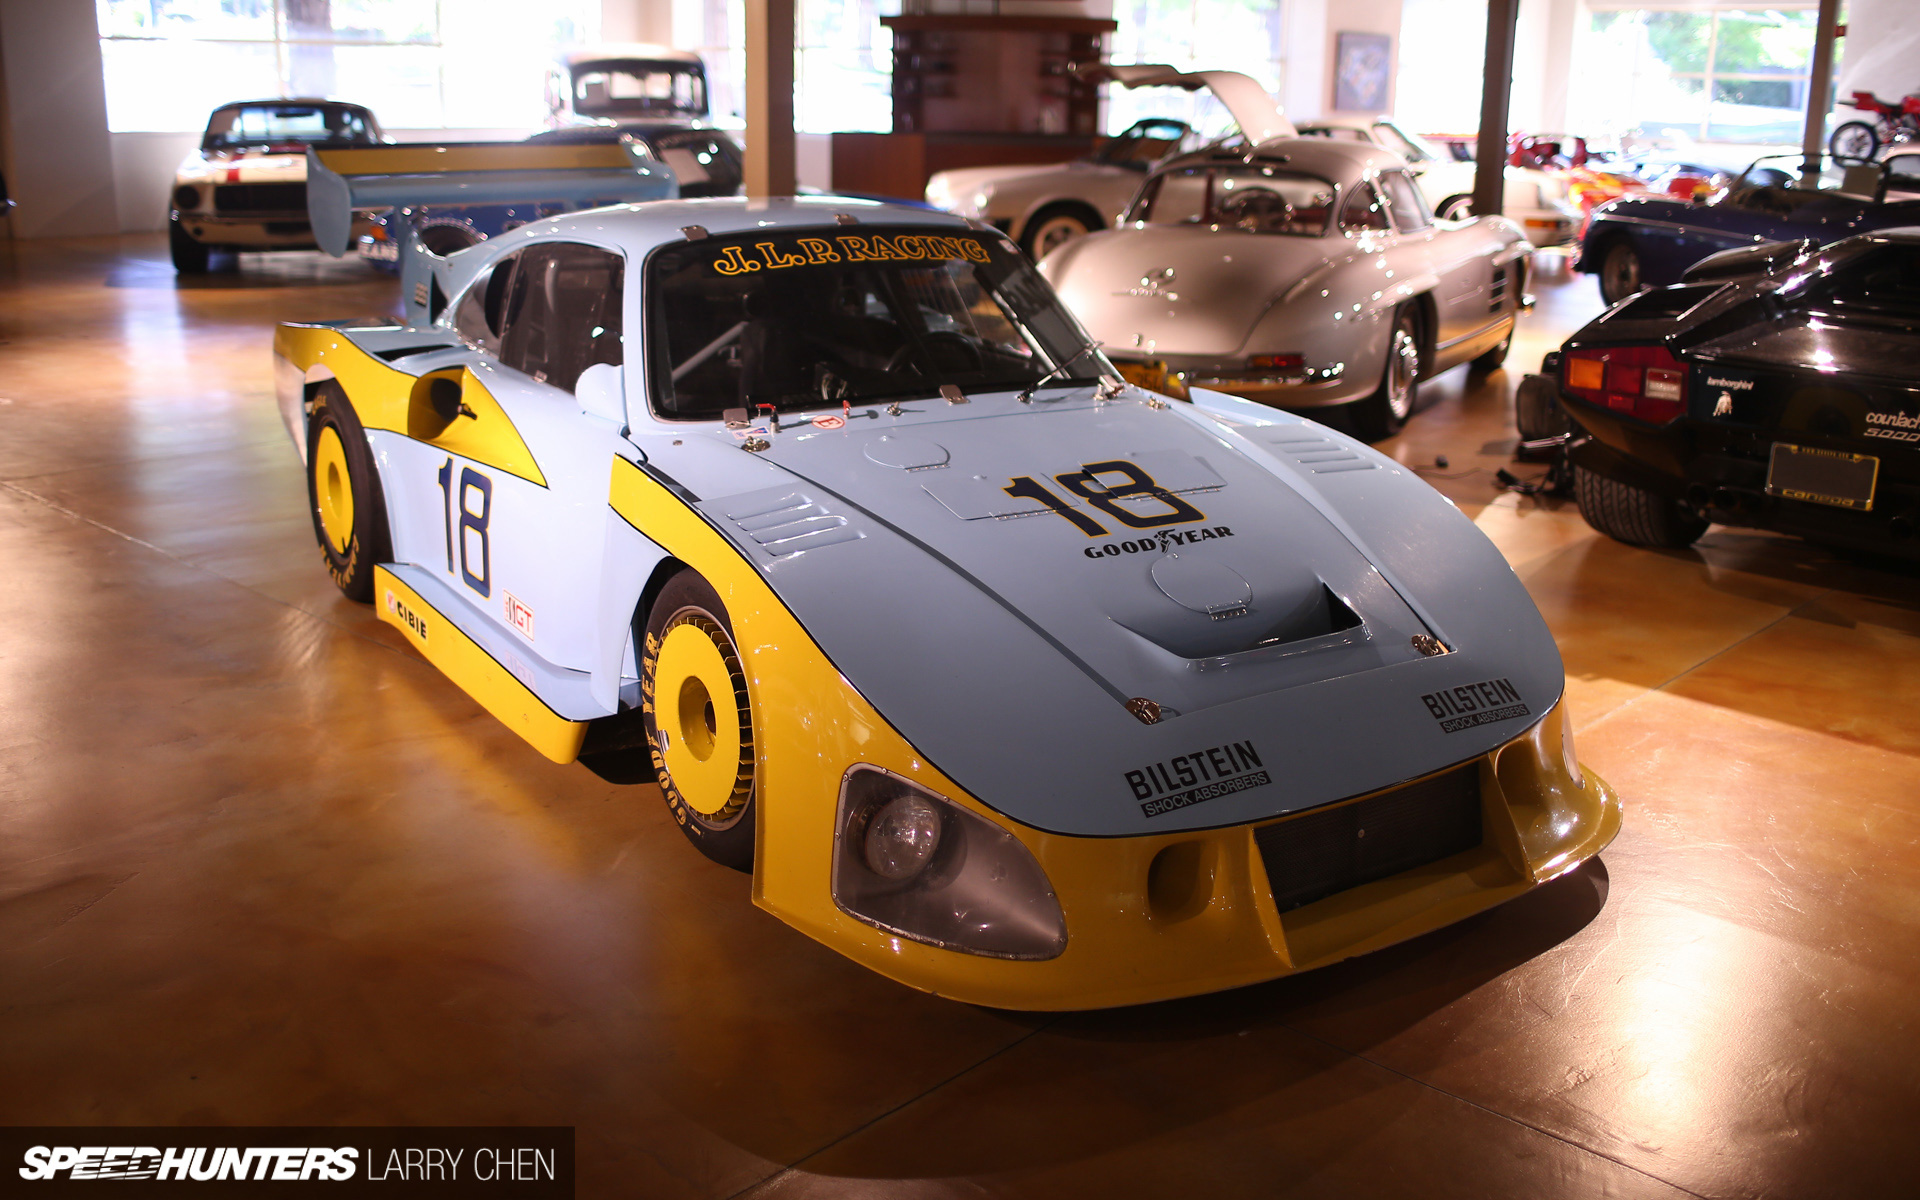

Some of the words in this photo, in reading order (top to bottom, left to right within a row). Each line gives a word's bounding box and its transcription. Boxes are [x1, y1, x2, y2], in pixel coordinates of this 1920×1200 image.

[714, 238, 841, 275] J.L.P.
[836, 235, 991, 263] RACING
[1863, 428, 1920, 442] 5000
[1001, 460, 1207, 538] 18
[438, 455, 492, 600] 18
[1421, 678, 1522, 720] BILSTEIN
[1442, 716, 1477, 733] SHOCK
[1477, 704, 1528, 724] ABSORBERS
[1124, 740, 1263, 801] BILSTEIN
[1145, 792, 1192, 816] SHOCK
[1194, 773, 1268, 802] ABSORBERS
